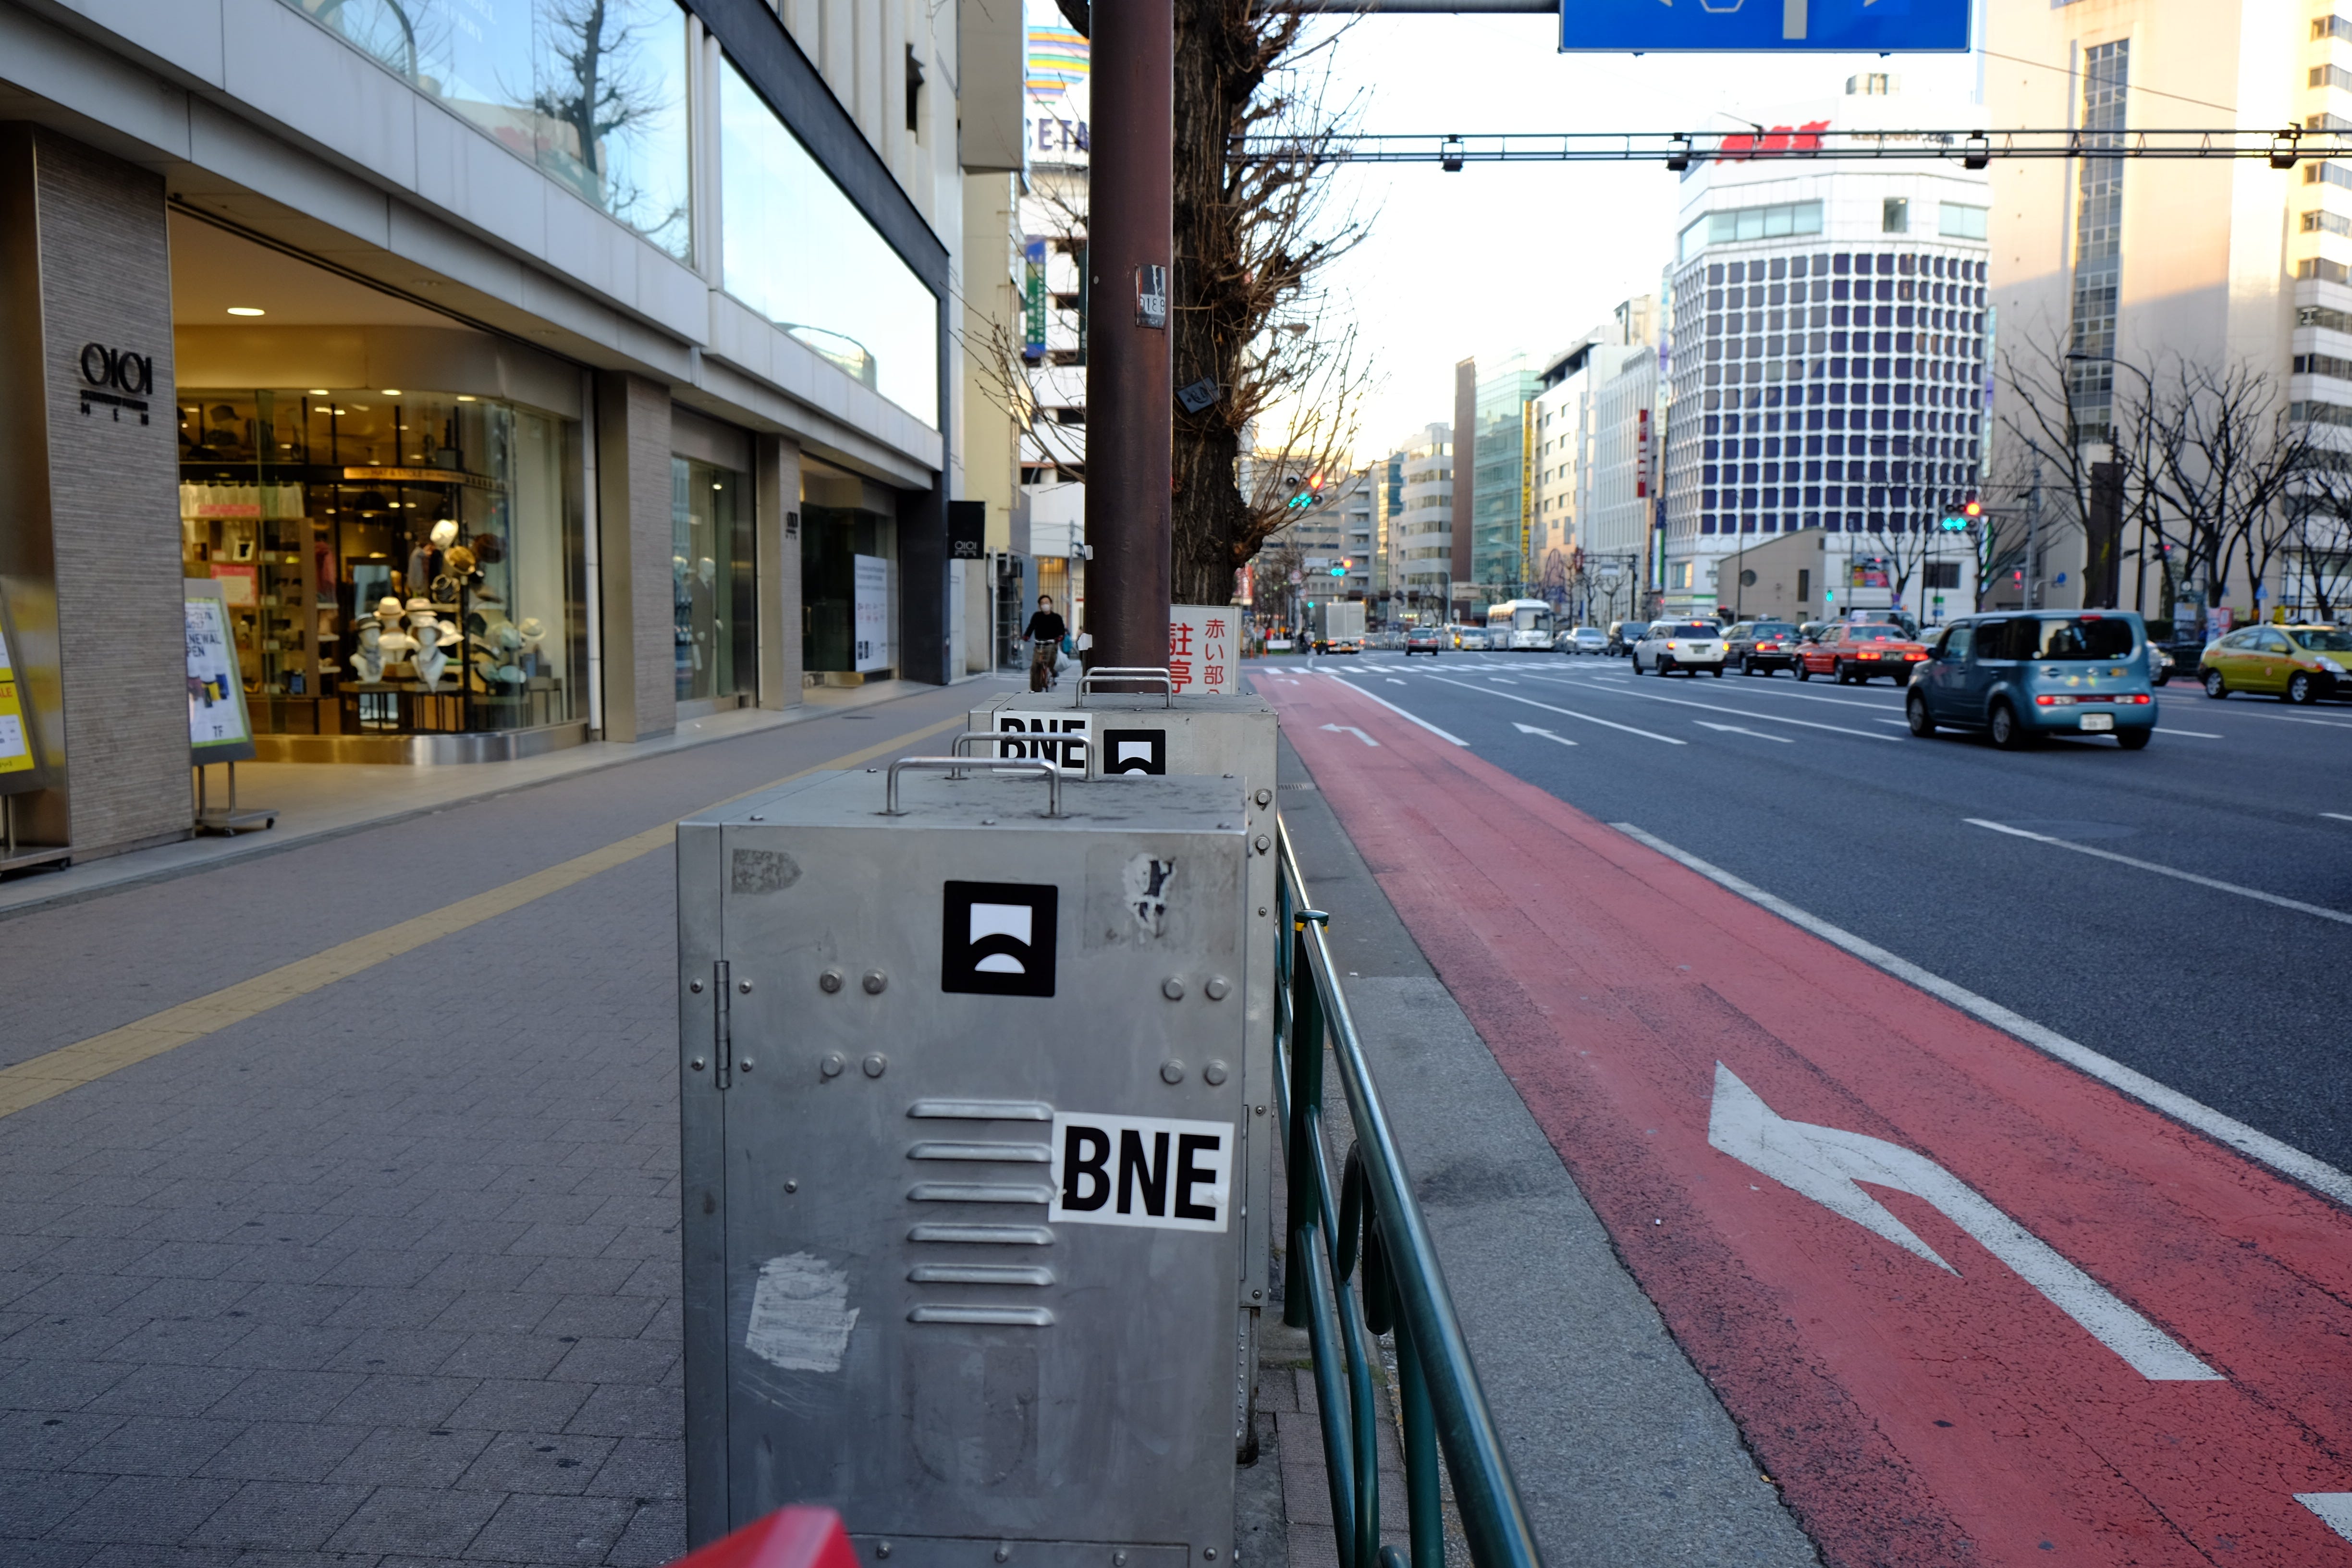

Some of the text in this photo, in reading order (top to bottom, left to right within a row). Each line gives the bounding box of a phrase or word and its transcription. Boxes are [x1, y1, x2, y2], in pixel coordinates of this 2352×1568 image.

[1204, 619, 1225, 694] 赤い部
[1000, 718, 1085, 769] BNE
[1062, 1126, 1220, 1221] BNE
